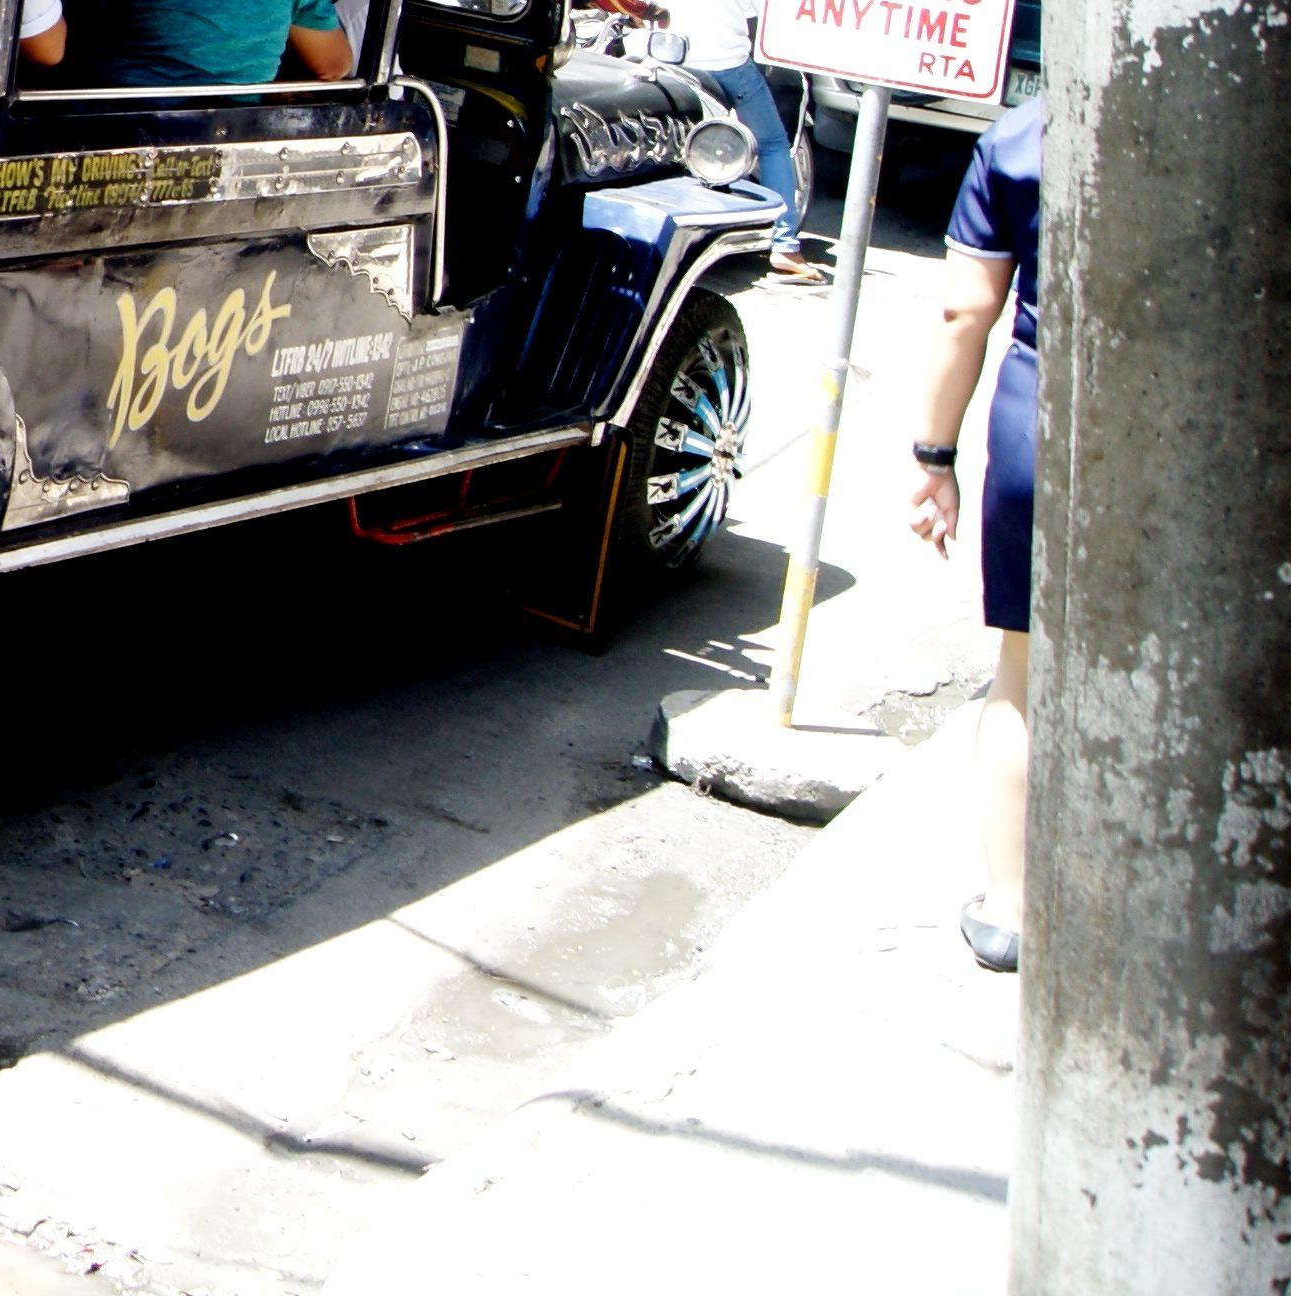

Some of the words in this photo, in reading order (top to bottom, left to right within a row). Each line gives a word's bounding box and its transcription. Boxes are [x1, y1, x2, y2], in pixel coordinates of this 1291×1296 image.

[918, 51, 976, 83] RTA
[51, 156, 77, 184] MY
[108, 270, 291, 449] Bogs
[271, 344, 307, 377] LTFRB
[305, 338, 333, 373] 24/7
